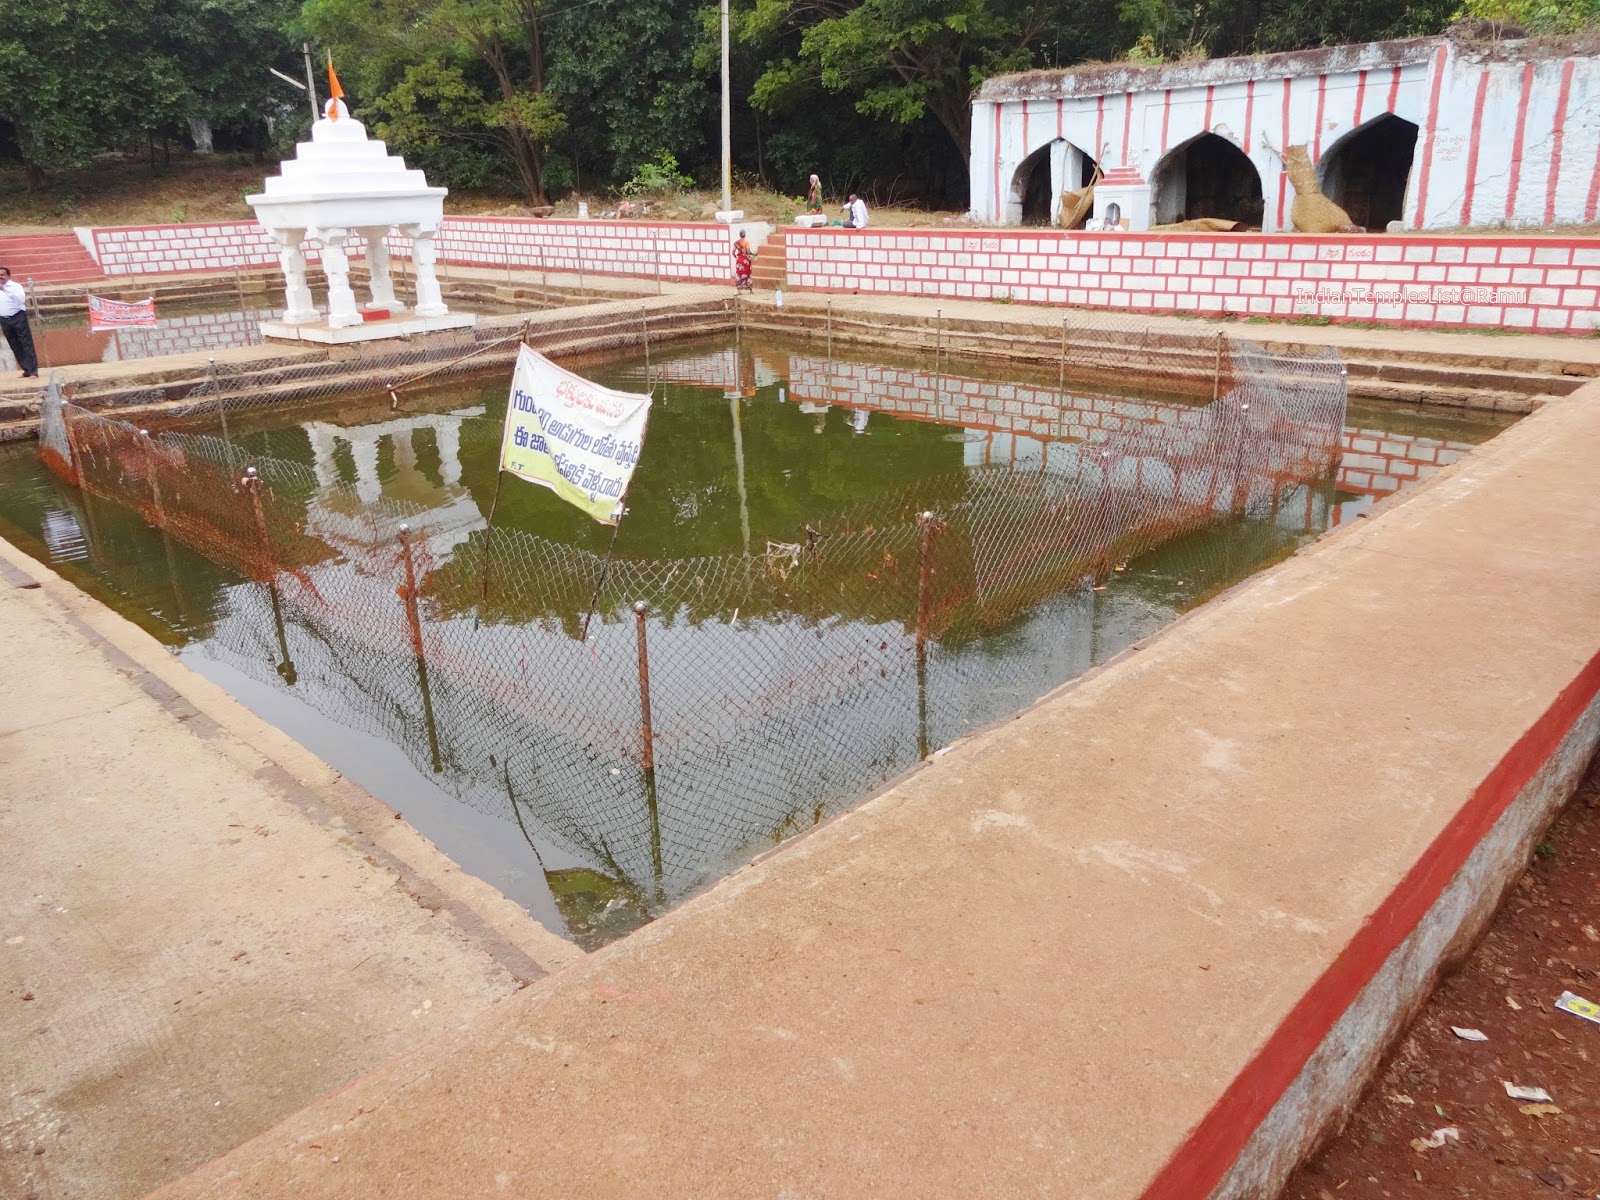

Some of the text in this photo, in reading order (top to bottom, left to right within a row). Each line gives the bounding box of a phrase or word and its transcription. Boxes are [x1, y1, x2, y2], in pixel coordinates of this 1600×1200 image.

[555, 380, 594, 409] భక్తులకు
[514, 426, 528, 448] ఈ
[550, 418, 592, 452] అడుగుల
[591, 433, 618, 462] లోతు
